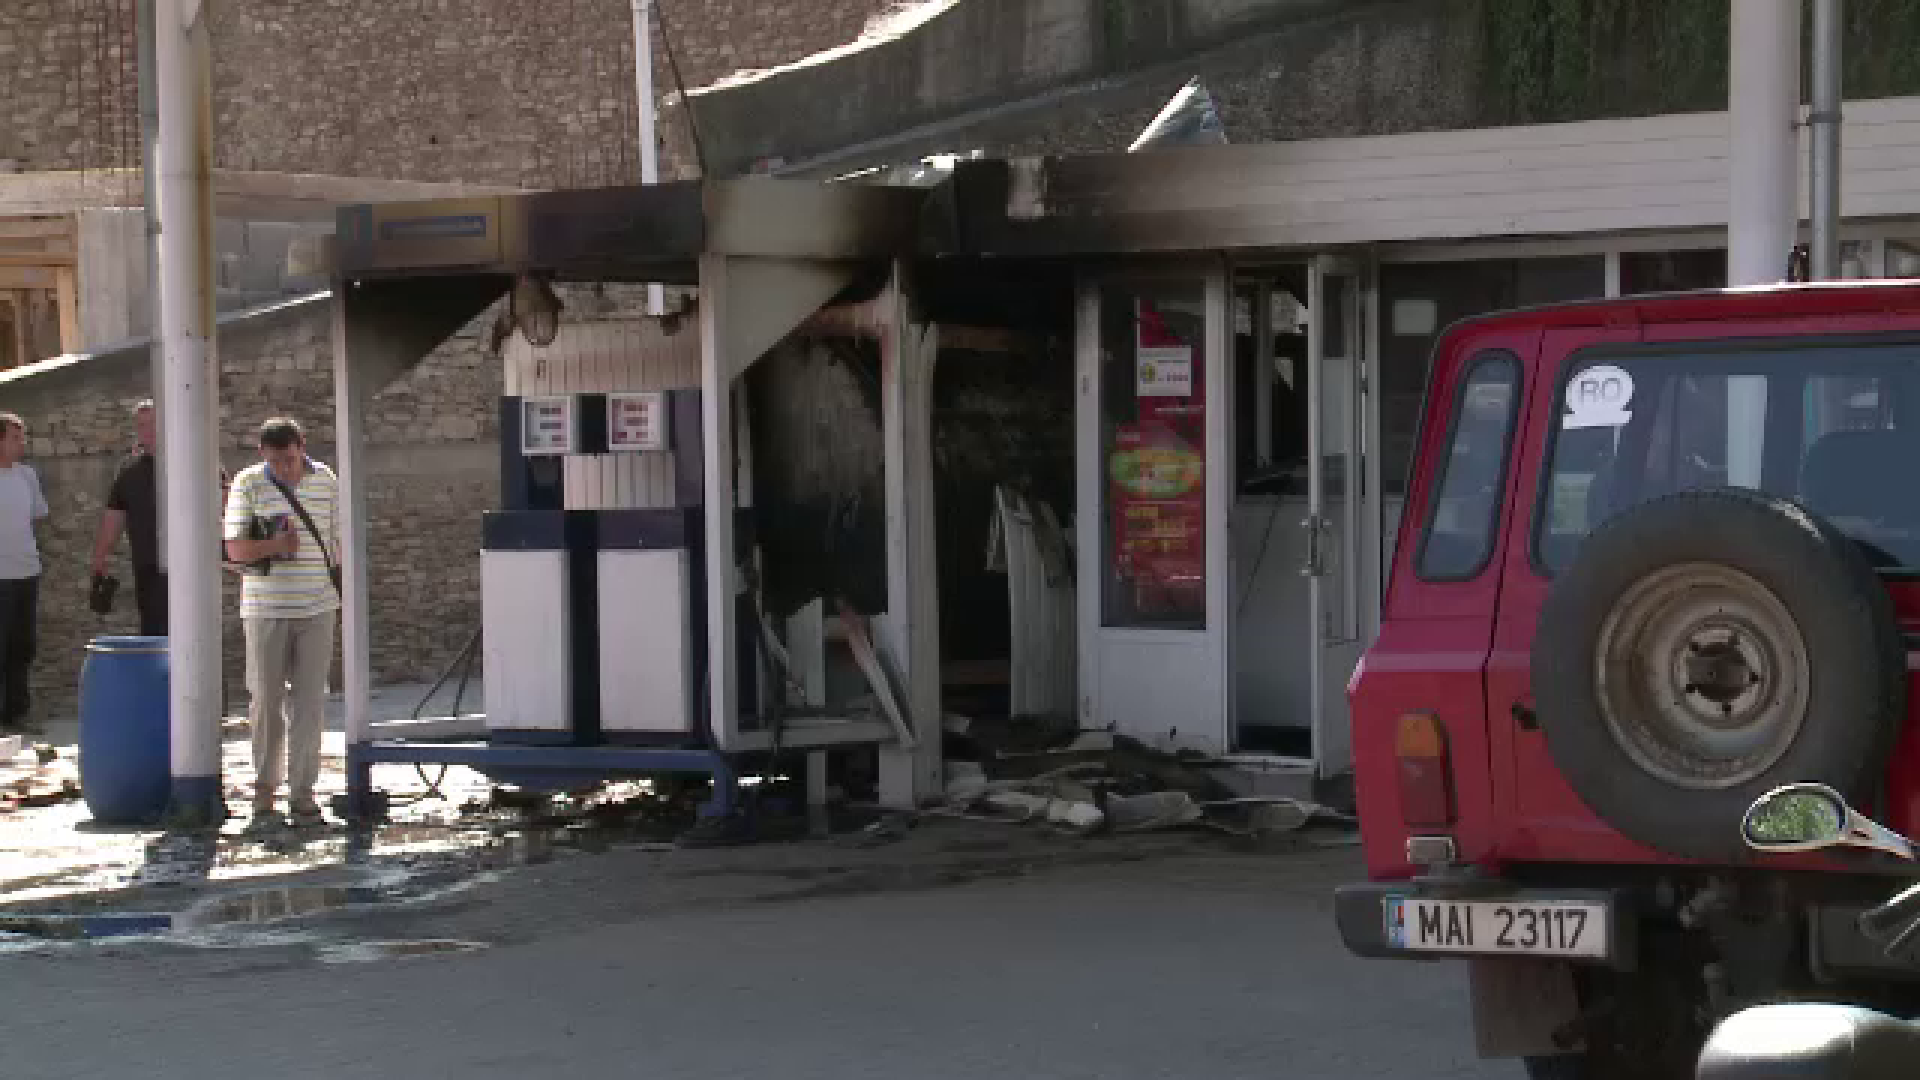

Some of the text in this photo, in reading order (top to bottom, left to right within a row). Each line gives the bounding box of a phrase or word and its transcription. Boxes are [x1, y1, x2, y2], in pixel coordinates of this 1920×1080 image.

[1580, 378, 1623, 405] RO
[1418, 905, 1474, 946] MAI
[1494, 908, 1588, 949] 23117
